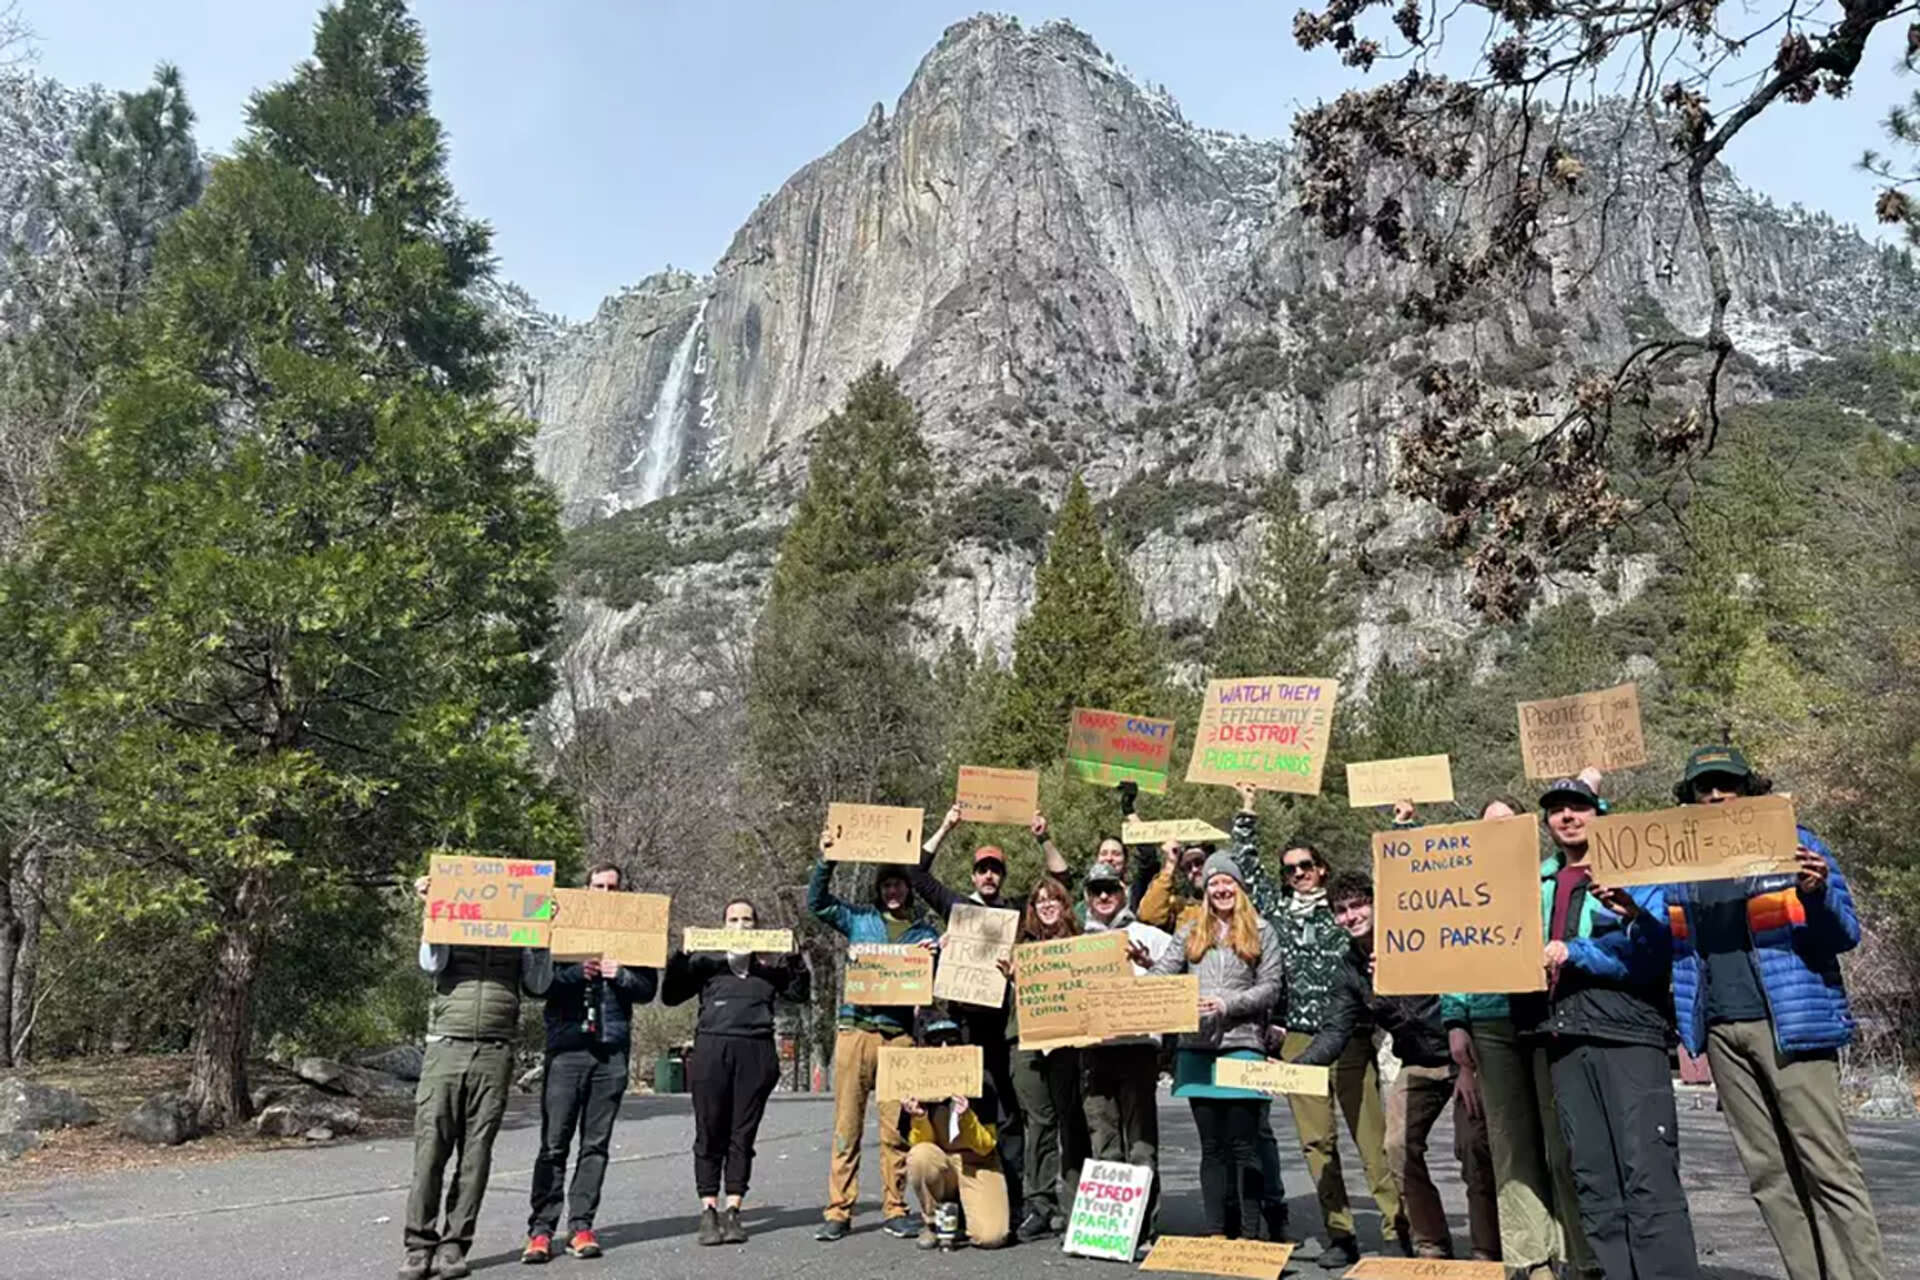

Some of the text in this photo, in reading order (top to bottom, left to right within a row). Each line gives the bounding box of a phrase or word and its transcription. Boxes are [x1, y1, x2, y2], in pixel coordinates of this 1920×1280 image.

[1219, 683, 1321, 703] WATCH THEM
[1219, 707, 1313, 724] EFFICIENTLY
[1523, 702, 1606, 726] PROTECT
[1219, 723, 1300, 745] DESTROY
[1528, 718, 1625, 740] PEOPLE WHO
[1530, 729, 1637, 760] PROTECT YOUR
[1202, 747, 1313, 777] PUBLIC LANDS
[849, 813, 895, 830] STAFF
[1721, 805, 1754, 825] NO
[1383, 836, 1471, 859] NO PARK
[1595, 825, 1639, 871] NO
[1719, 831, 1777, 859] Safety
[1411, 855, 1473, 873] RANGERS
[454, 883, 523, 902] NOT
[1398, 882, 1491, 911] EQUALS
[431, 900, 482, 922] FIRE
[460, 923, 508, 938] THEM
[1386, 928, 1425, 954] NO
[954, 967, 992, 986] FIRE
[1091, 1165, 1132, 1183] ELON
[1084, 1197, 1123, 1218] YOUR
[1077, 1211, 1119, 1232] PARK
[1072, 1230, 1131, 1255] RANGERS
